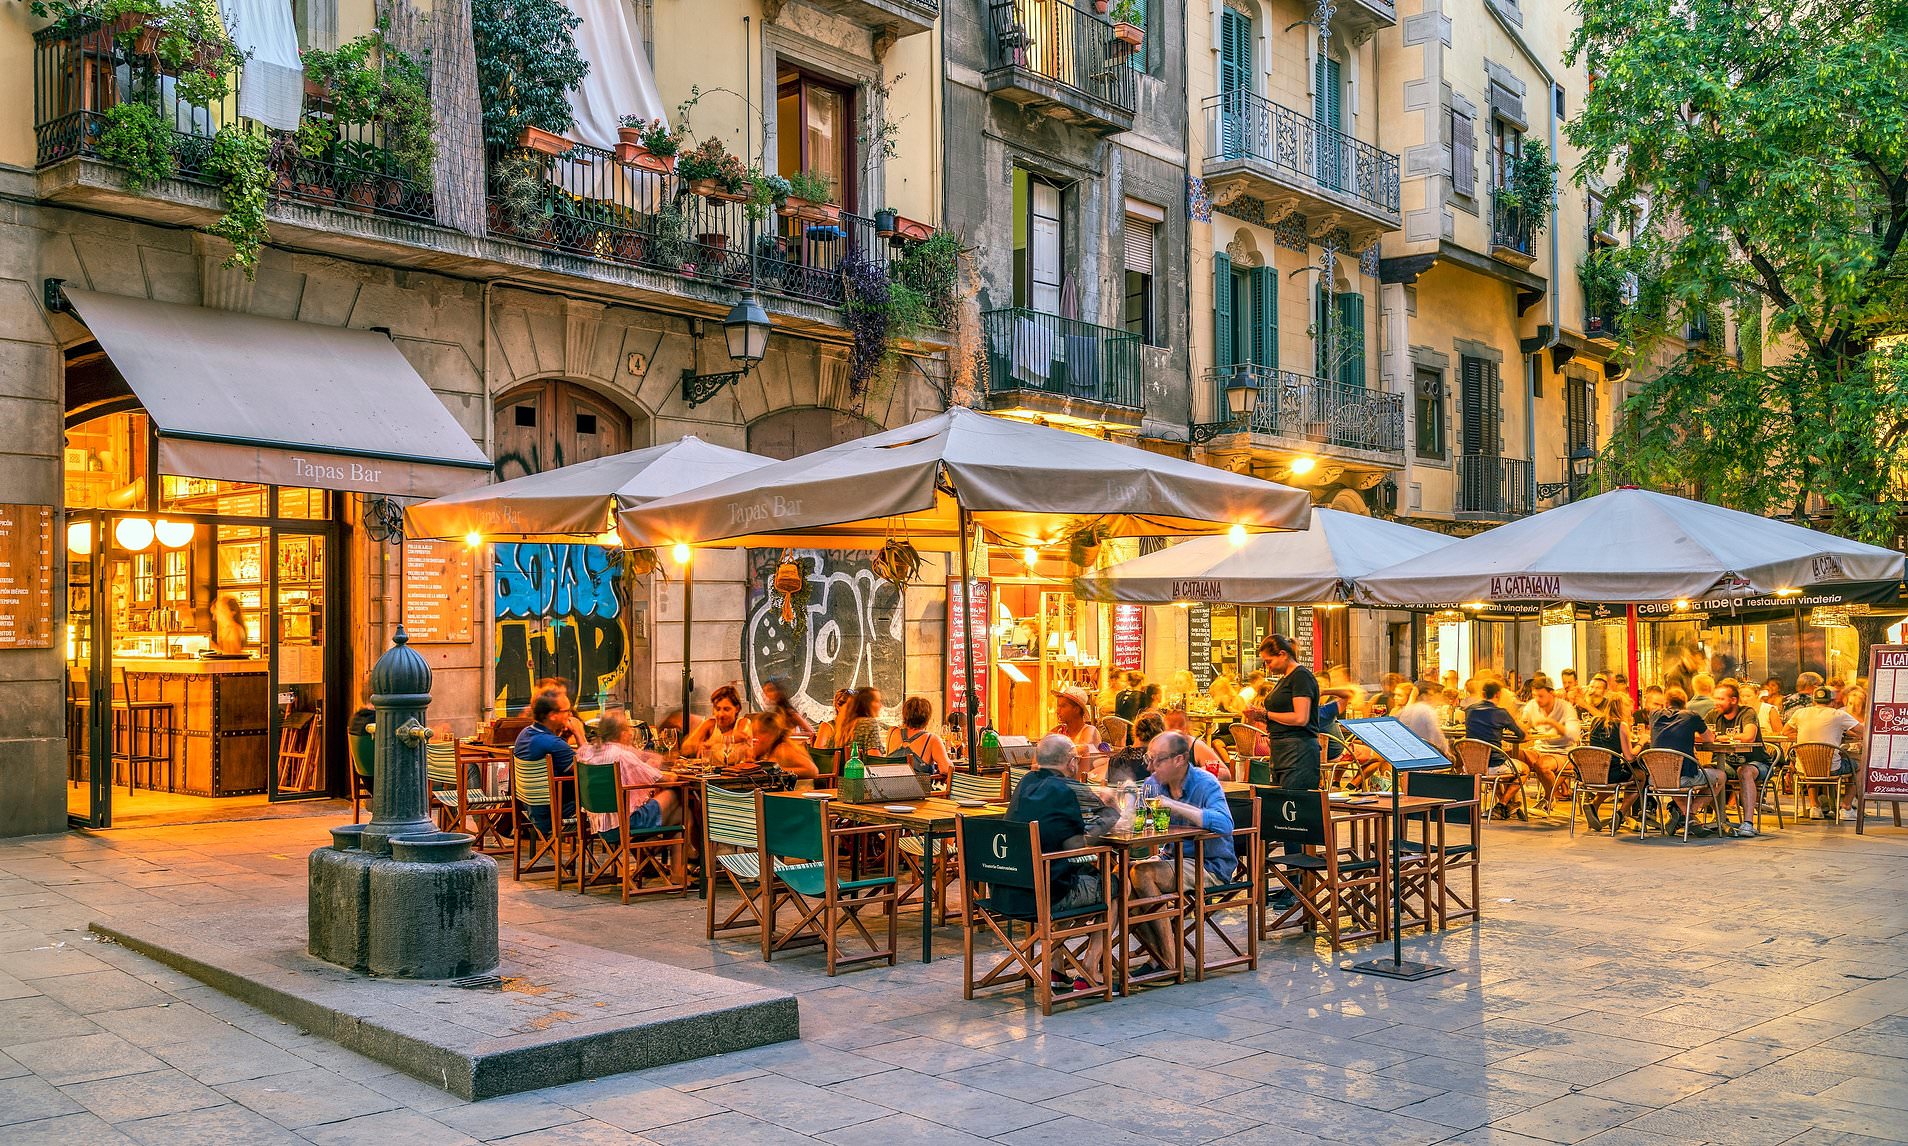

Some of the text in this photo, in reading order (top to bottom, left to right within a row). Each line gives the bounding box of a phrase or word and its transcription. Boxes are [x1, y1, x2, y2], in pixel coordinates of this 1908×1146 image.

[635, 358, 640, 370] 4
[292, 458, 381, 482] Tapas Bar
[727, 496, 802, 528] Tapas Bar
[1172, 581, 1221, 597] LA CATALANA
[1491, 575, 1560, 595] LA CATALANA
[1503, 604, 1539, 613] vinateria
[1747, 596, 1796, 607] restaurant
[1798, 594, 1842, 605] vinateria
[1881, 653, 1893, 666] LA
[1282, 800, 1297, 822] G
[992, 833, 1009, 859] G
